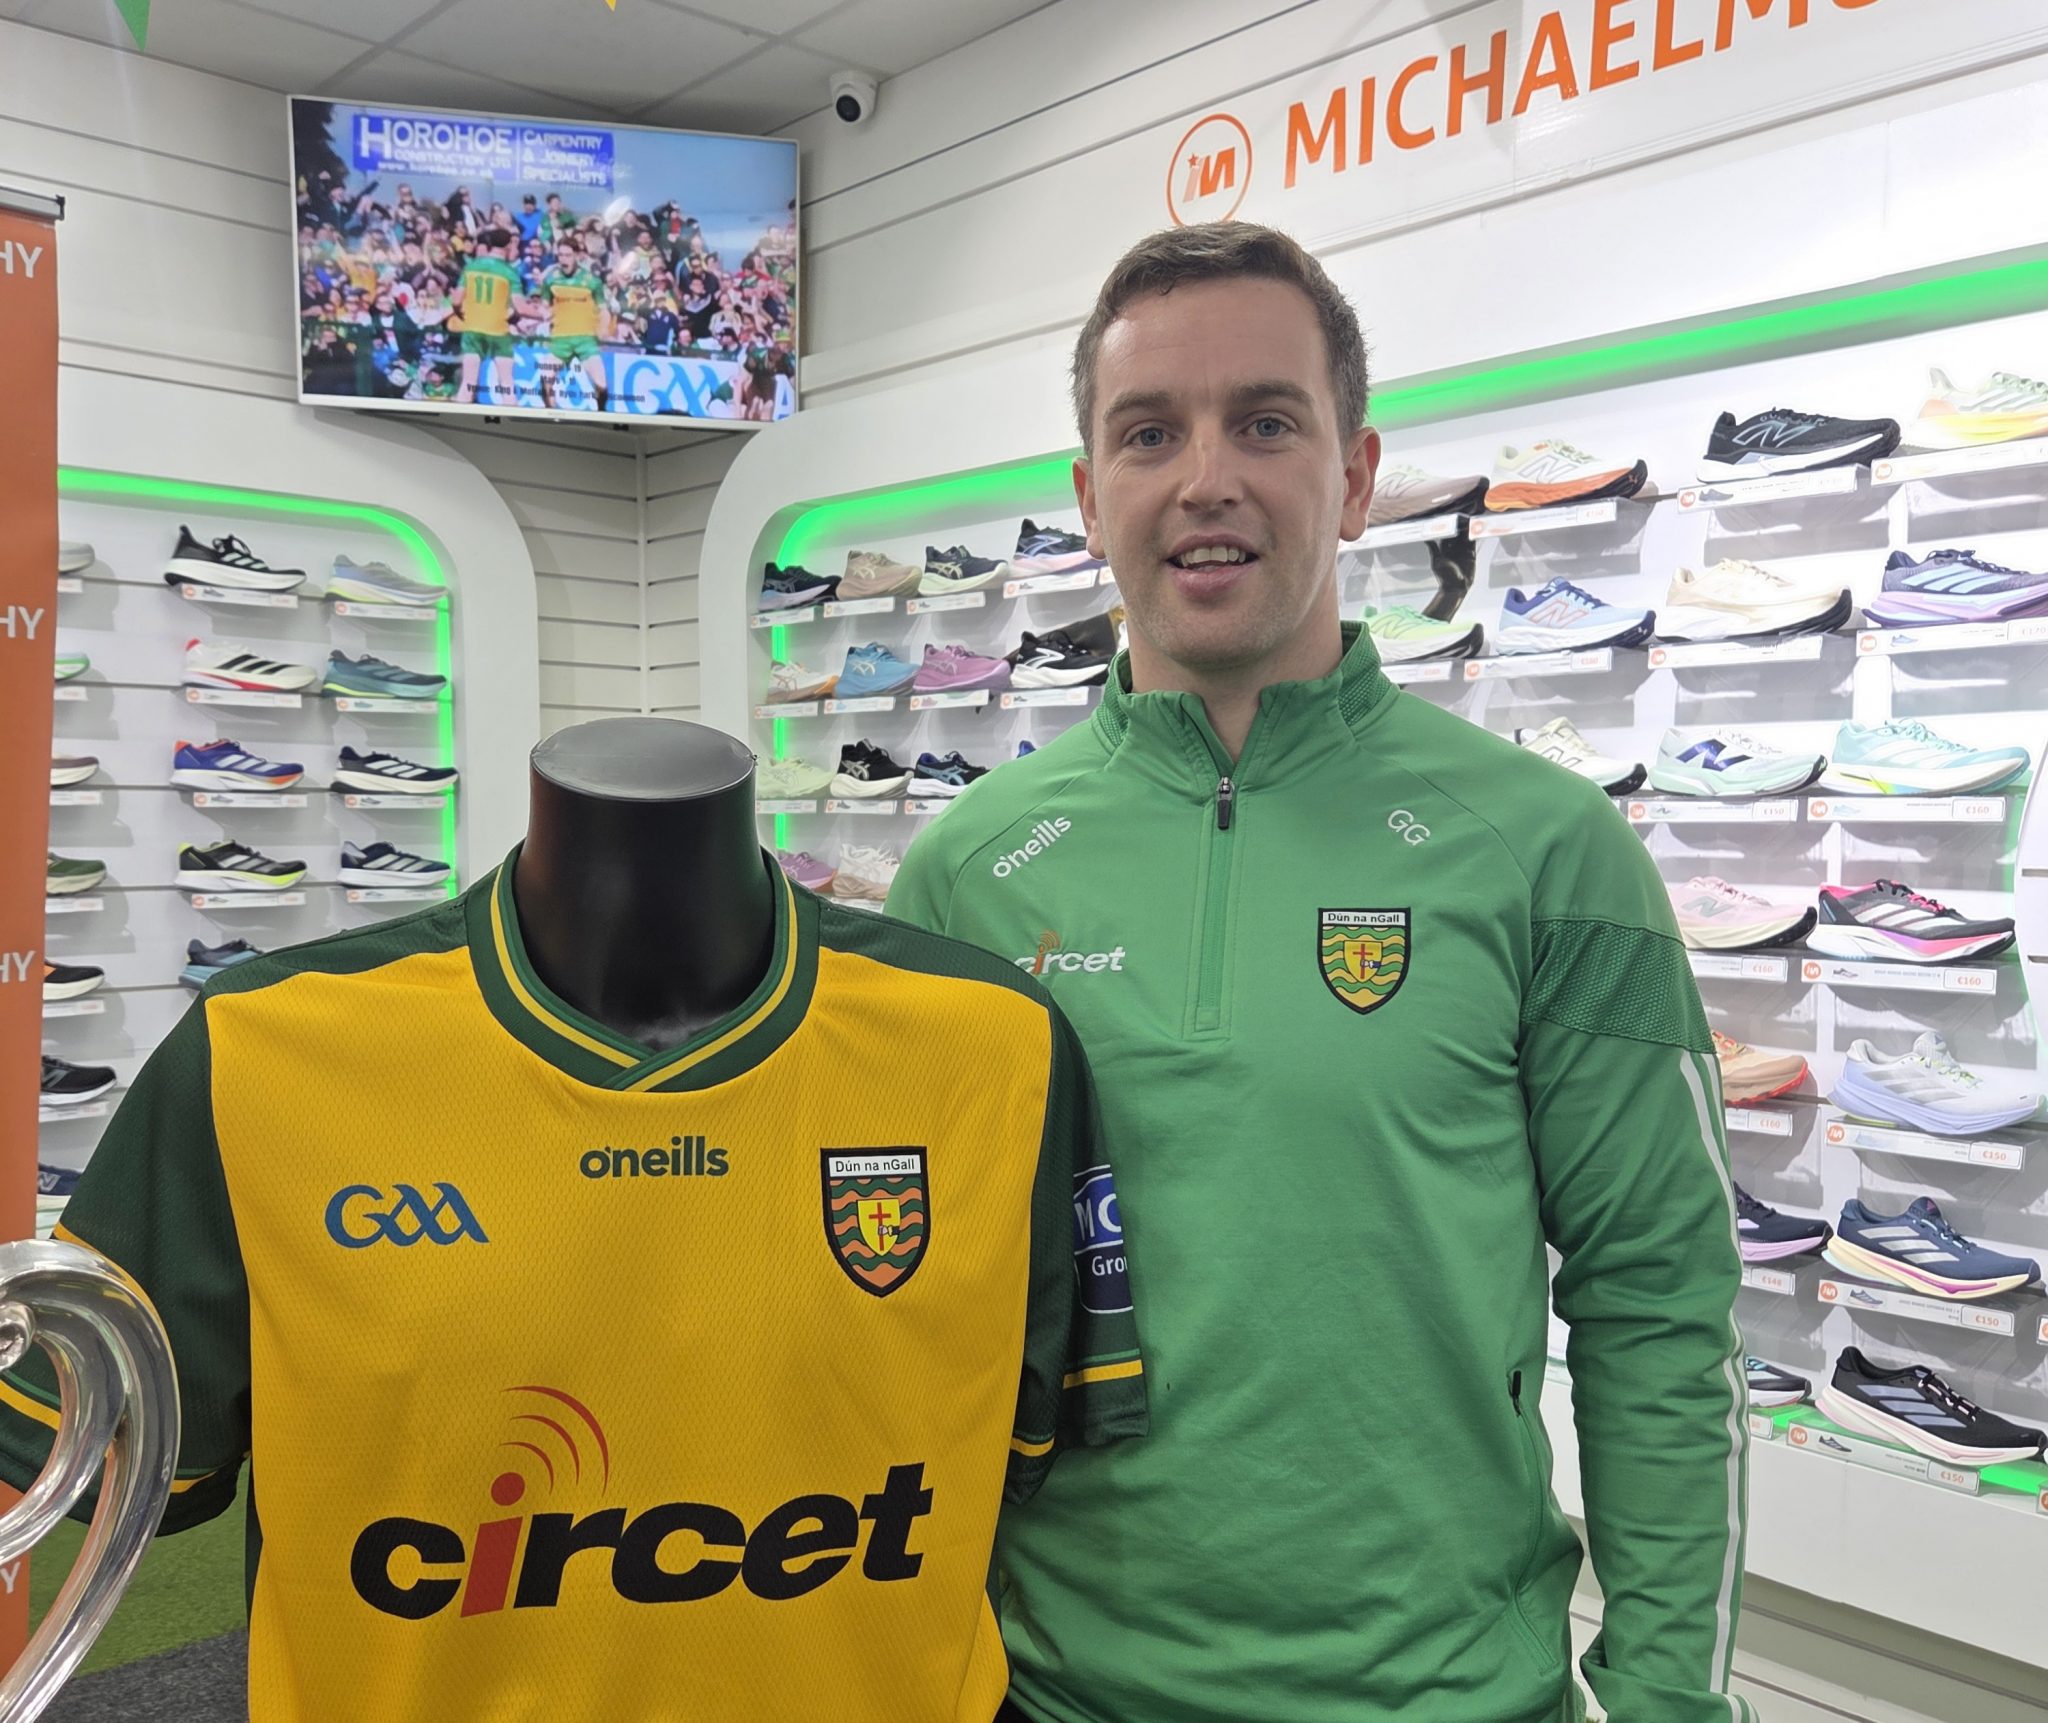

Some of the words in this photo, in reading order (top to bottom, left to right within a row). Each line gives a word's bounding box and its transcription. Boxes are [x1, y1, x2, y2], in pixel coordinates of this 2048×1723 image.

[1284, 0, 1878, 189] MICHAELM
[360, 117, 512, 159] HOROHOE
[522, 130, 603, 149] CARPENTRY
[474, 275, 495, 305] 11
[1965, 805, 1990, 815] €160
[1388, 809, 1431, 846] GG
[1353, 915, 1367, 923] na
[1370, 914, 1400, 923] nGall
[1957, 976, 1982, 986] €160
[1982, 1150, 2007, 1161] €150
[835, 1159, 861, 1173] Dún
[864, 1161, 879, 1172] na
[883, 1158, 915, 1171] nGall
[324, 1182, 490, 1249] GAA
[1975, 1314, 2000, 1327] €150
[1940, 1470, 1964, 1484] €150
[350, 1462, 934, 1620] circet
